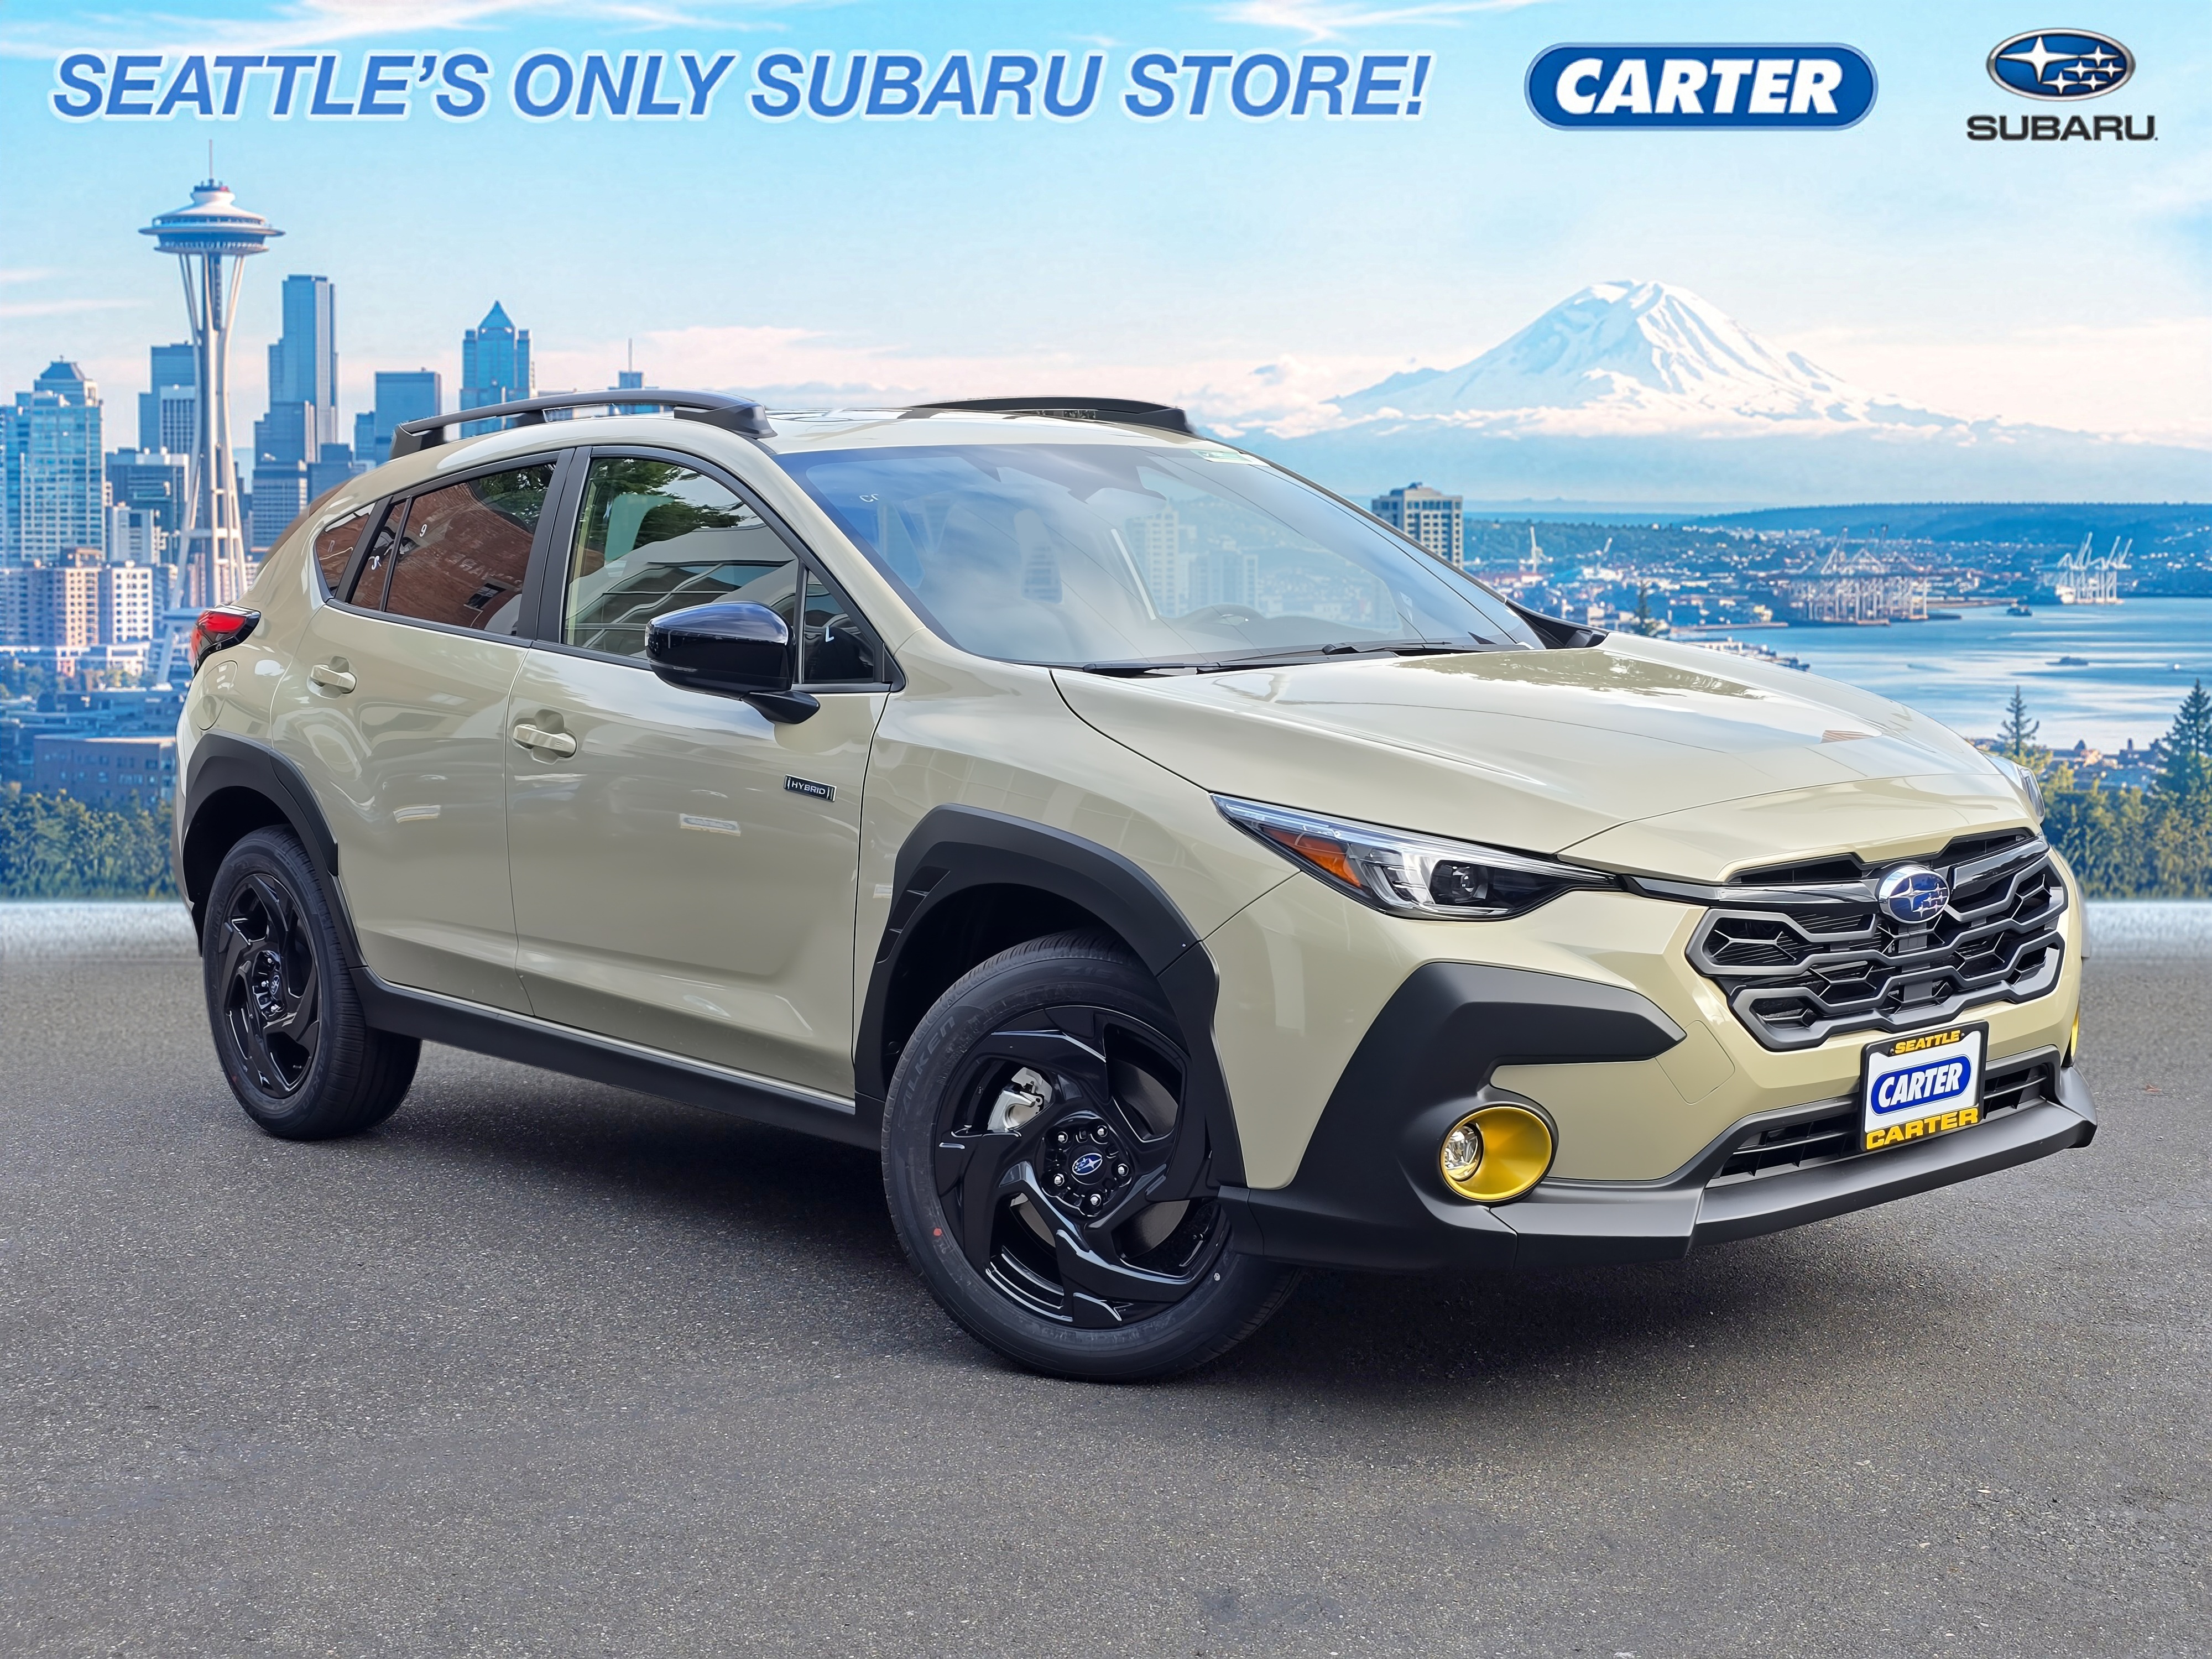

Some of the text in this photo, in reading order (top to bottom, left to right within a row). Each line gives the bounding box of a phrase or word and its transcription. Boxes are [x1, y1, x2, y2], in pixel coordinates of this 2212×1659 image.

[791, 780, 826, 795] HYBRID
[1895, 1030, 1960, 1055] SEATTLE
[1878, 1062, 1963, 1108] CARTER
[1866, 1108, 1979, 1150] CARTER
